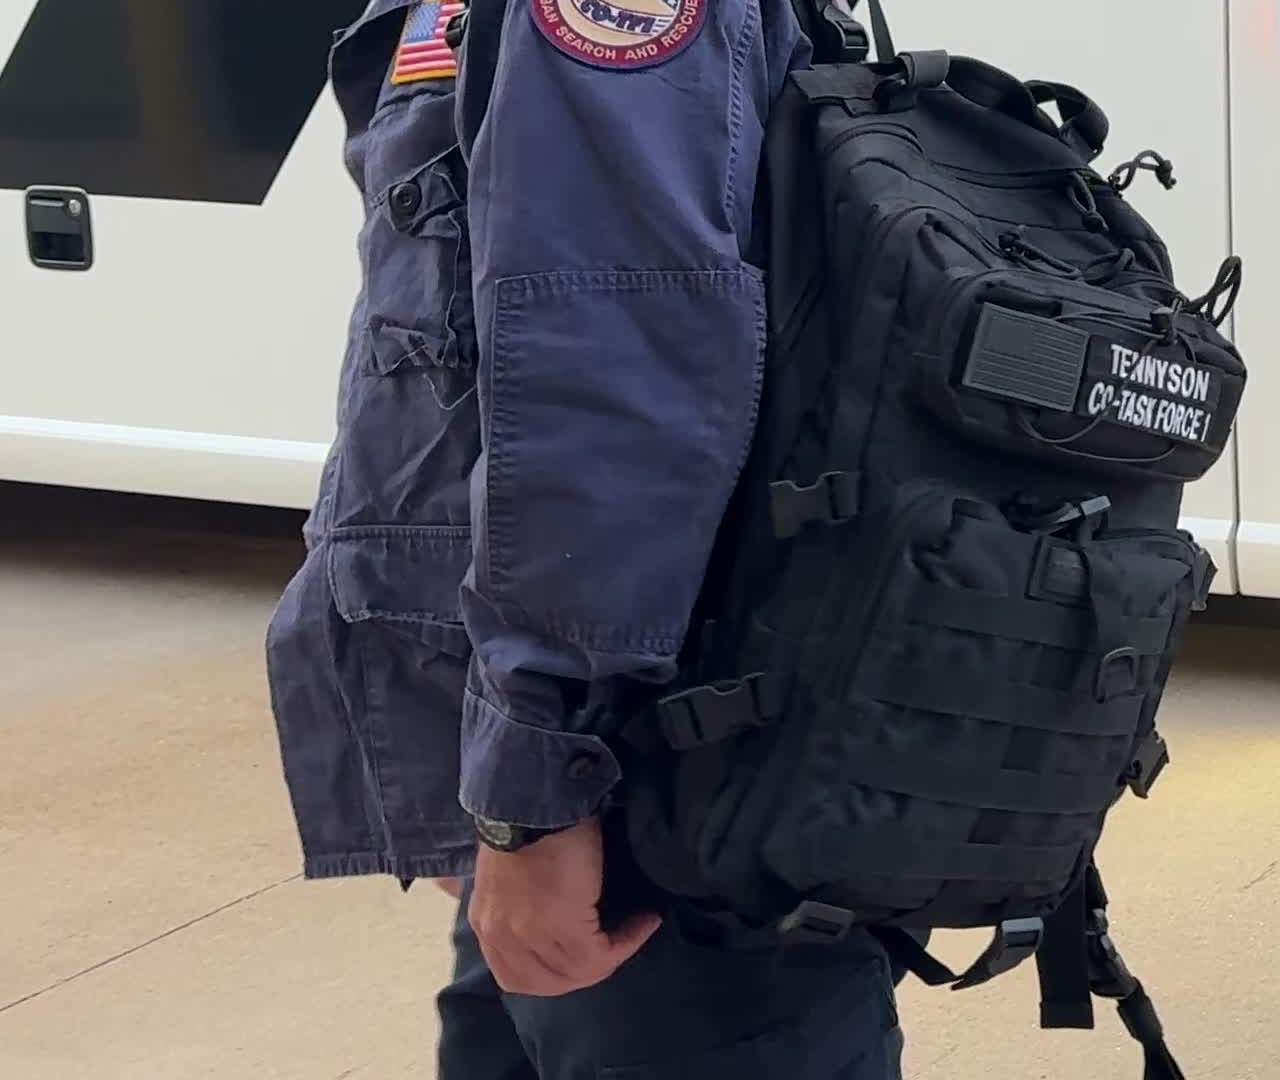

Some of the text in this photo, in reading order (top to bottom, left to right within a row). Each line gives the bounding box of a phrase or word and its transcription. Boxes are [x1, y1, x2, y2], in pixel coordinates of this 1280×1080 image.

[556, 25, 616, 60] SEARCH
[625, 43, 659, 61] AND
[1110, 343, 1210, 402] TENNYSON
[1153, 399, 1204, 440] FORCE
